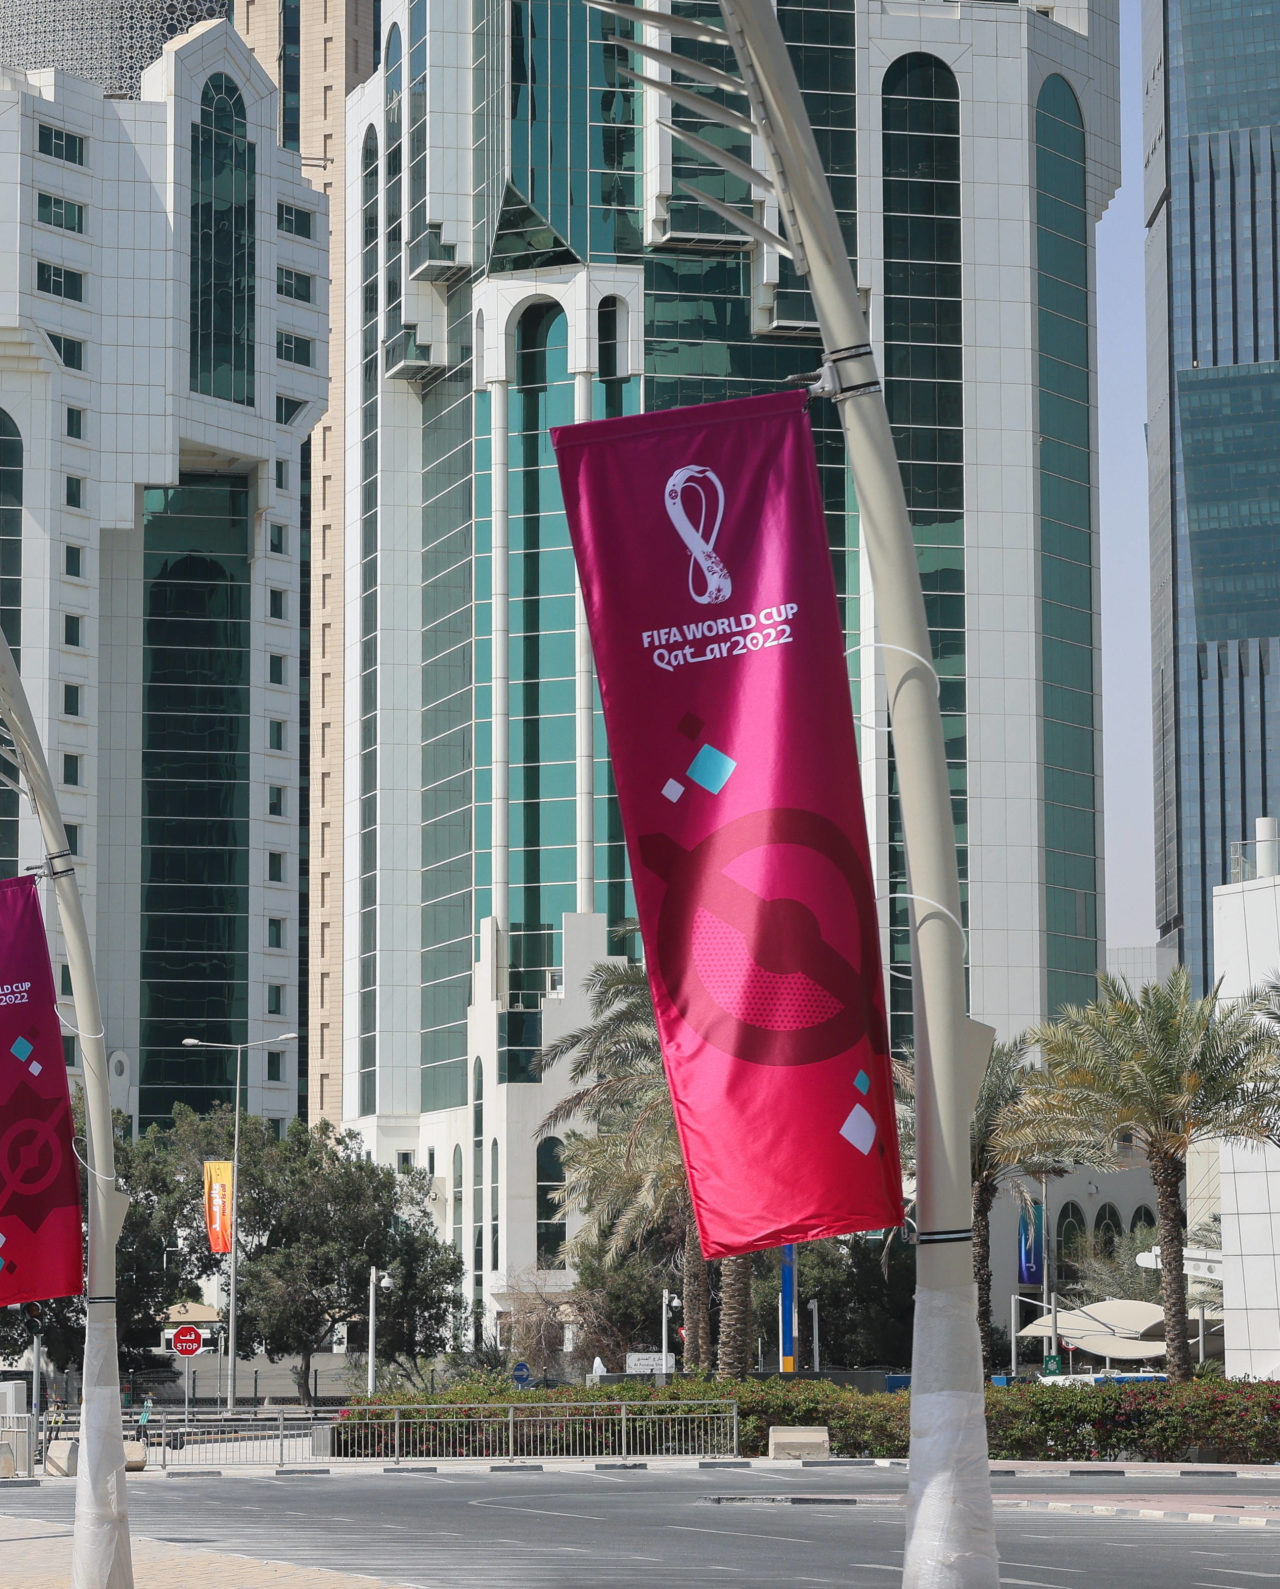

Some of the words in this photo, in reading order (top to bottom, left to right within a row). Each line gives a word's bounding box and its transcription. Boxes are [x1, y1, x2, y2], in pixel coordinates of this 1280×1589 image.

[642, 624, 683, 648] FIFA
[681, 612, 757, 642] WORLD
[759, 602, 799, 627] CUP
[12, 981, 31, 992] CUP
[179, 1331, 196, 1340] قف
[176, 1342, 199, 1350] STOP
